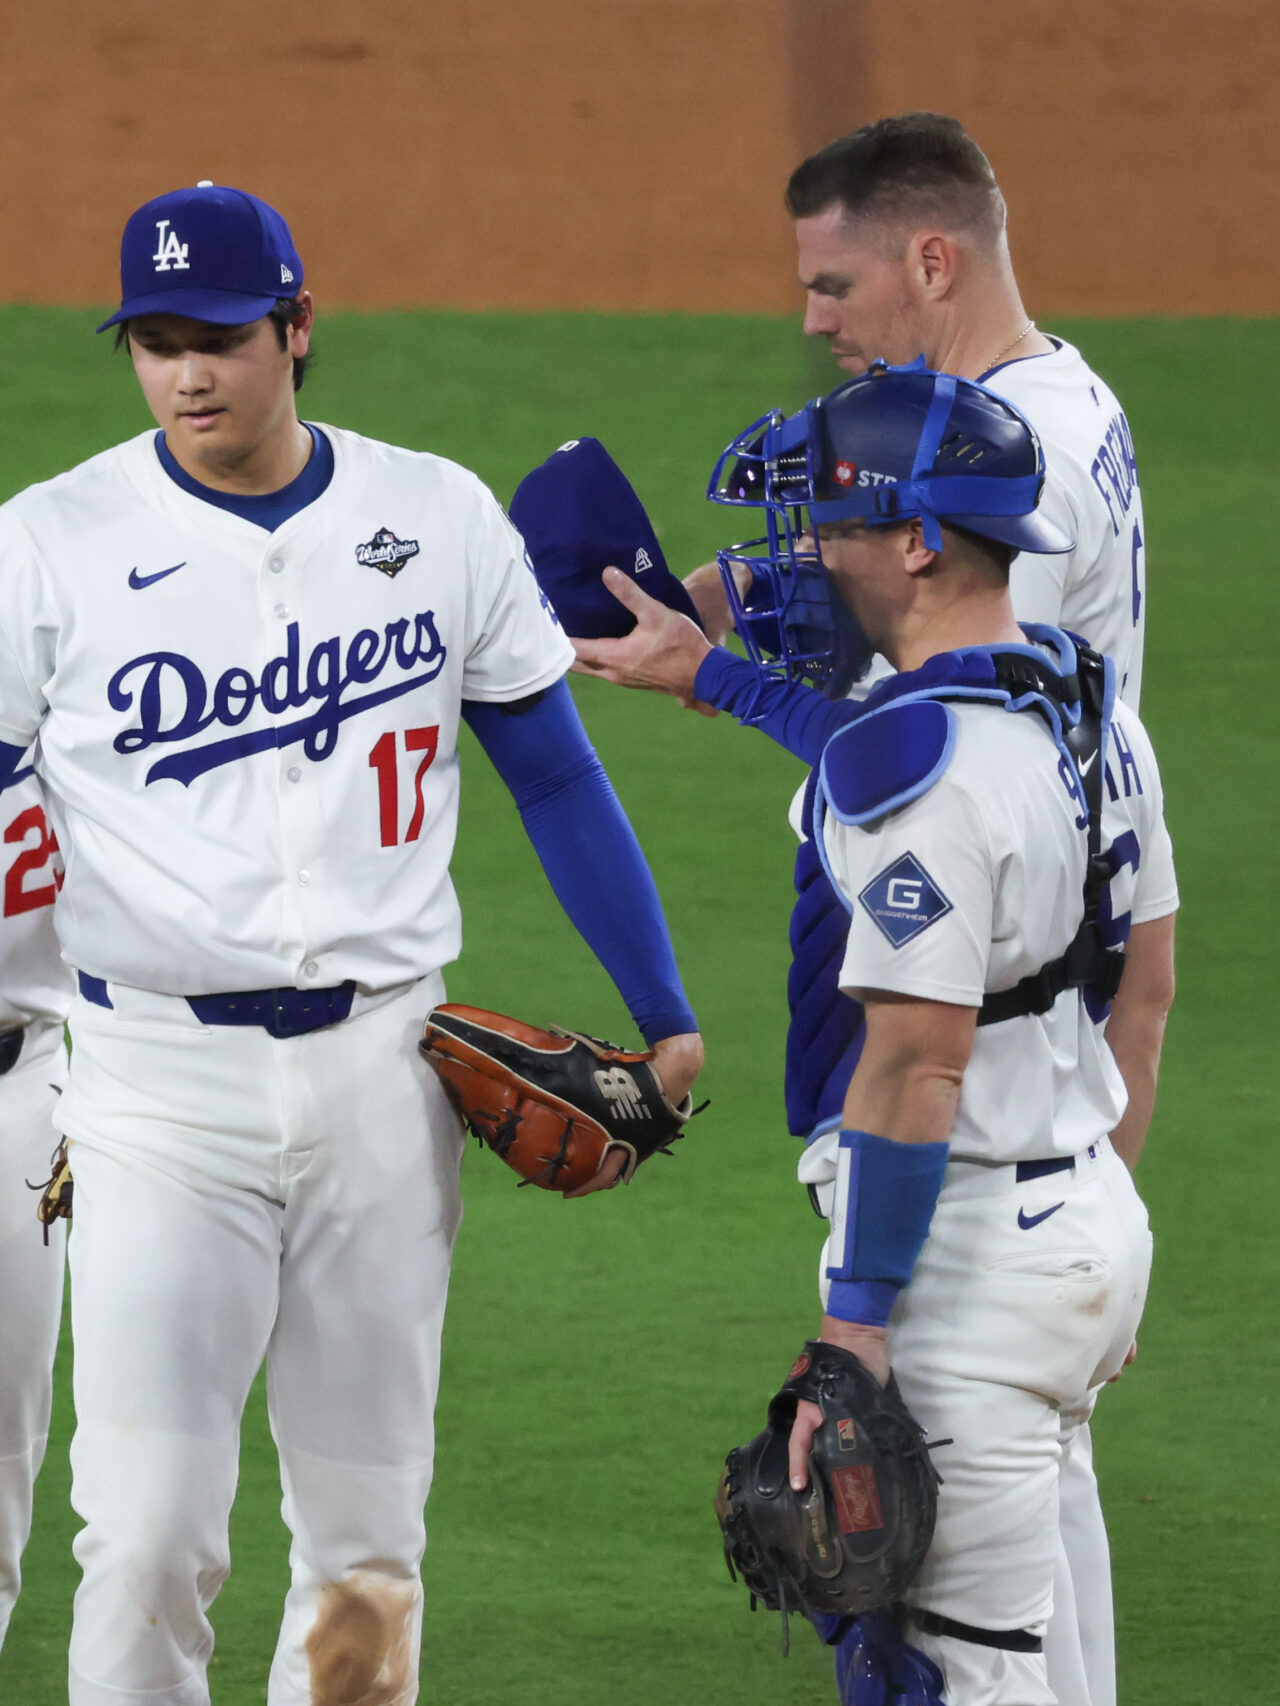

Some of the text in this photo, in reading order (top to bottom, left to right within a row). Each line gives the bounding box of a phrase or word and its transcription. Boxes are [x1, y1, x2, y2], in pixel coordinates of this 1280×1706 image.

[153, 219, 190, 272] LA
[107, 609, 447, 762] Dodgers
[368, 724, 440, 848] 17
